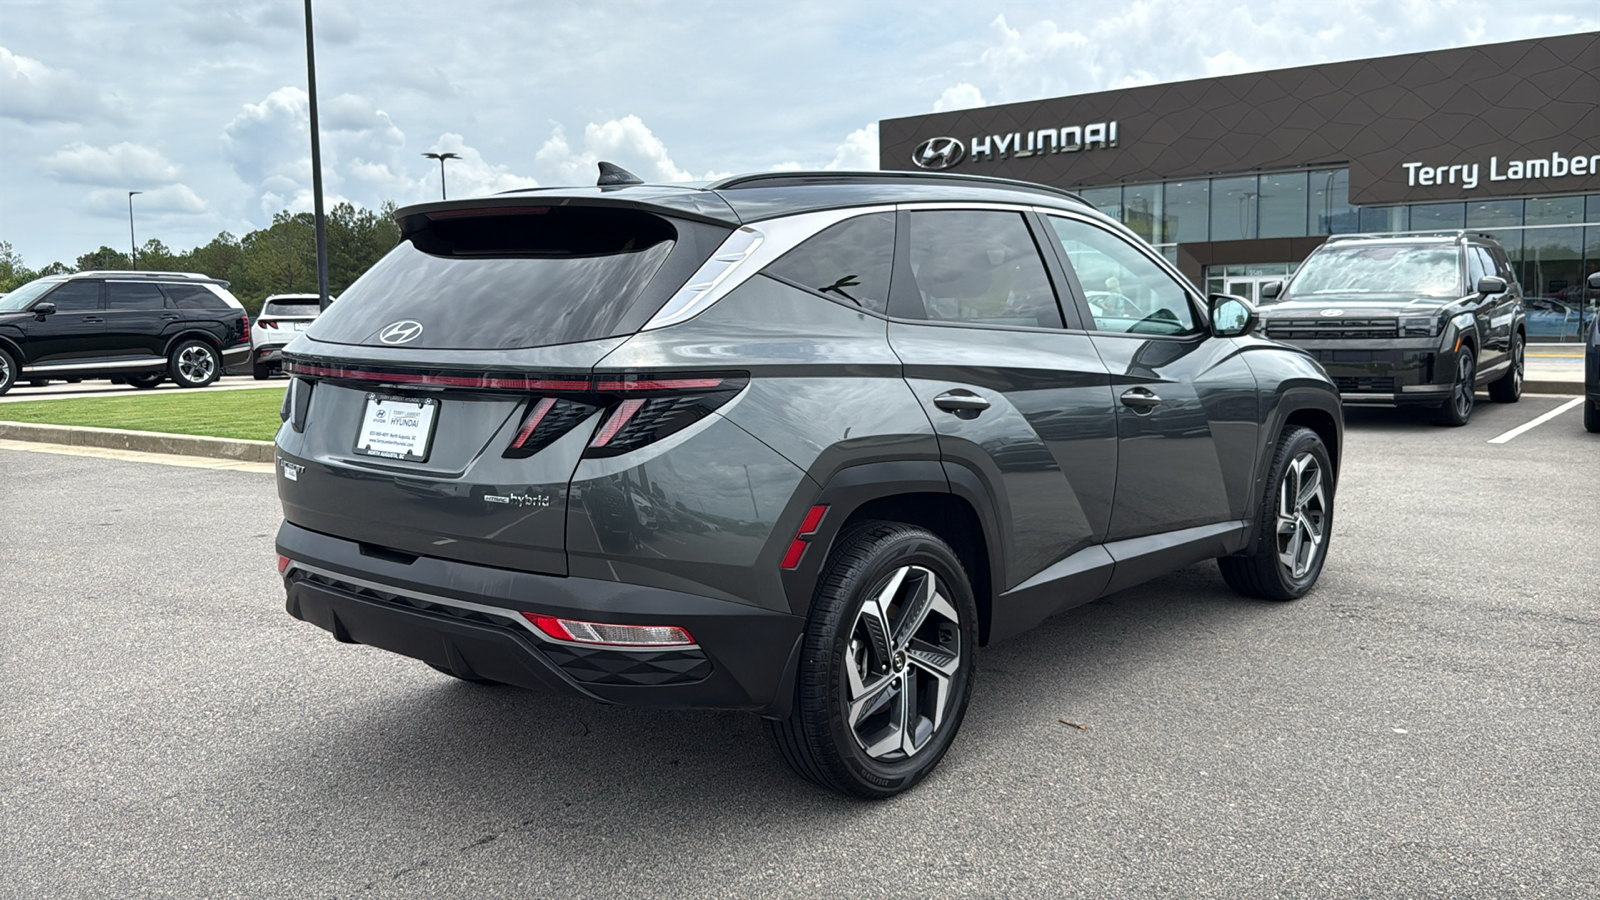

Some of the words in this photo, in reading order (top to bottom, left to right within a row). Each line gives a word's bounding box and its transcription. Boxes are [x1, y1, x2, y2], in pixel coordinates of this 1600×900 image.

[971, 121, 1118, 163] HYUNDAI
[1402, 162, 1479, 189] Terry
[1490, 151, 1600, 181] Lamber
[390, 418, 419, 427] HYUNDAI
[510, 492, 550, 508] hybrid
